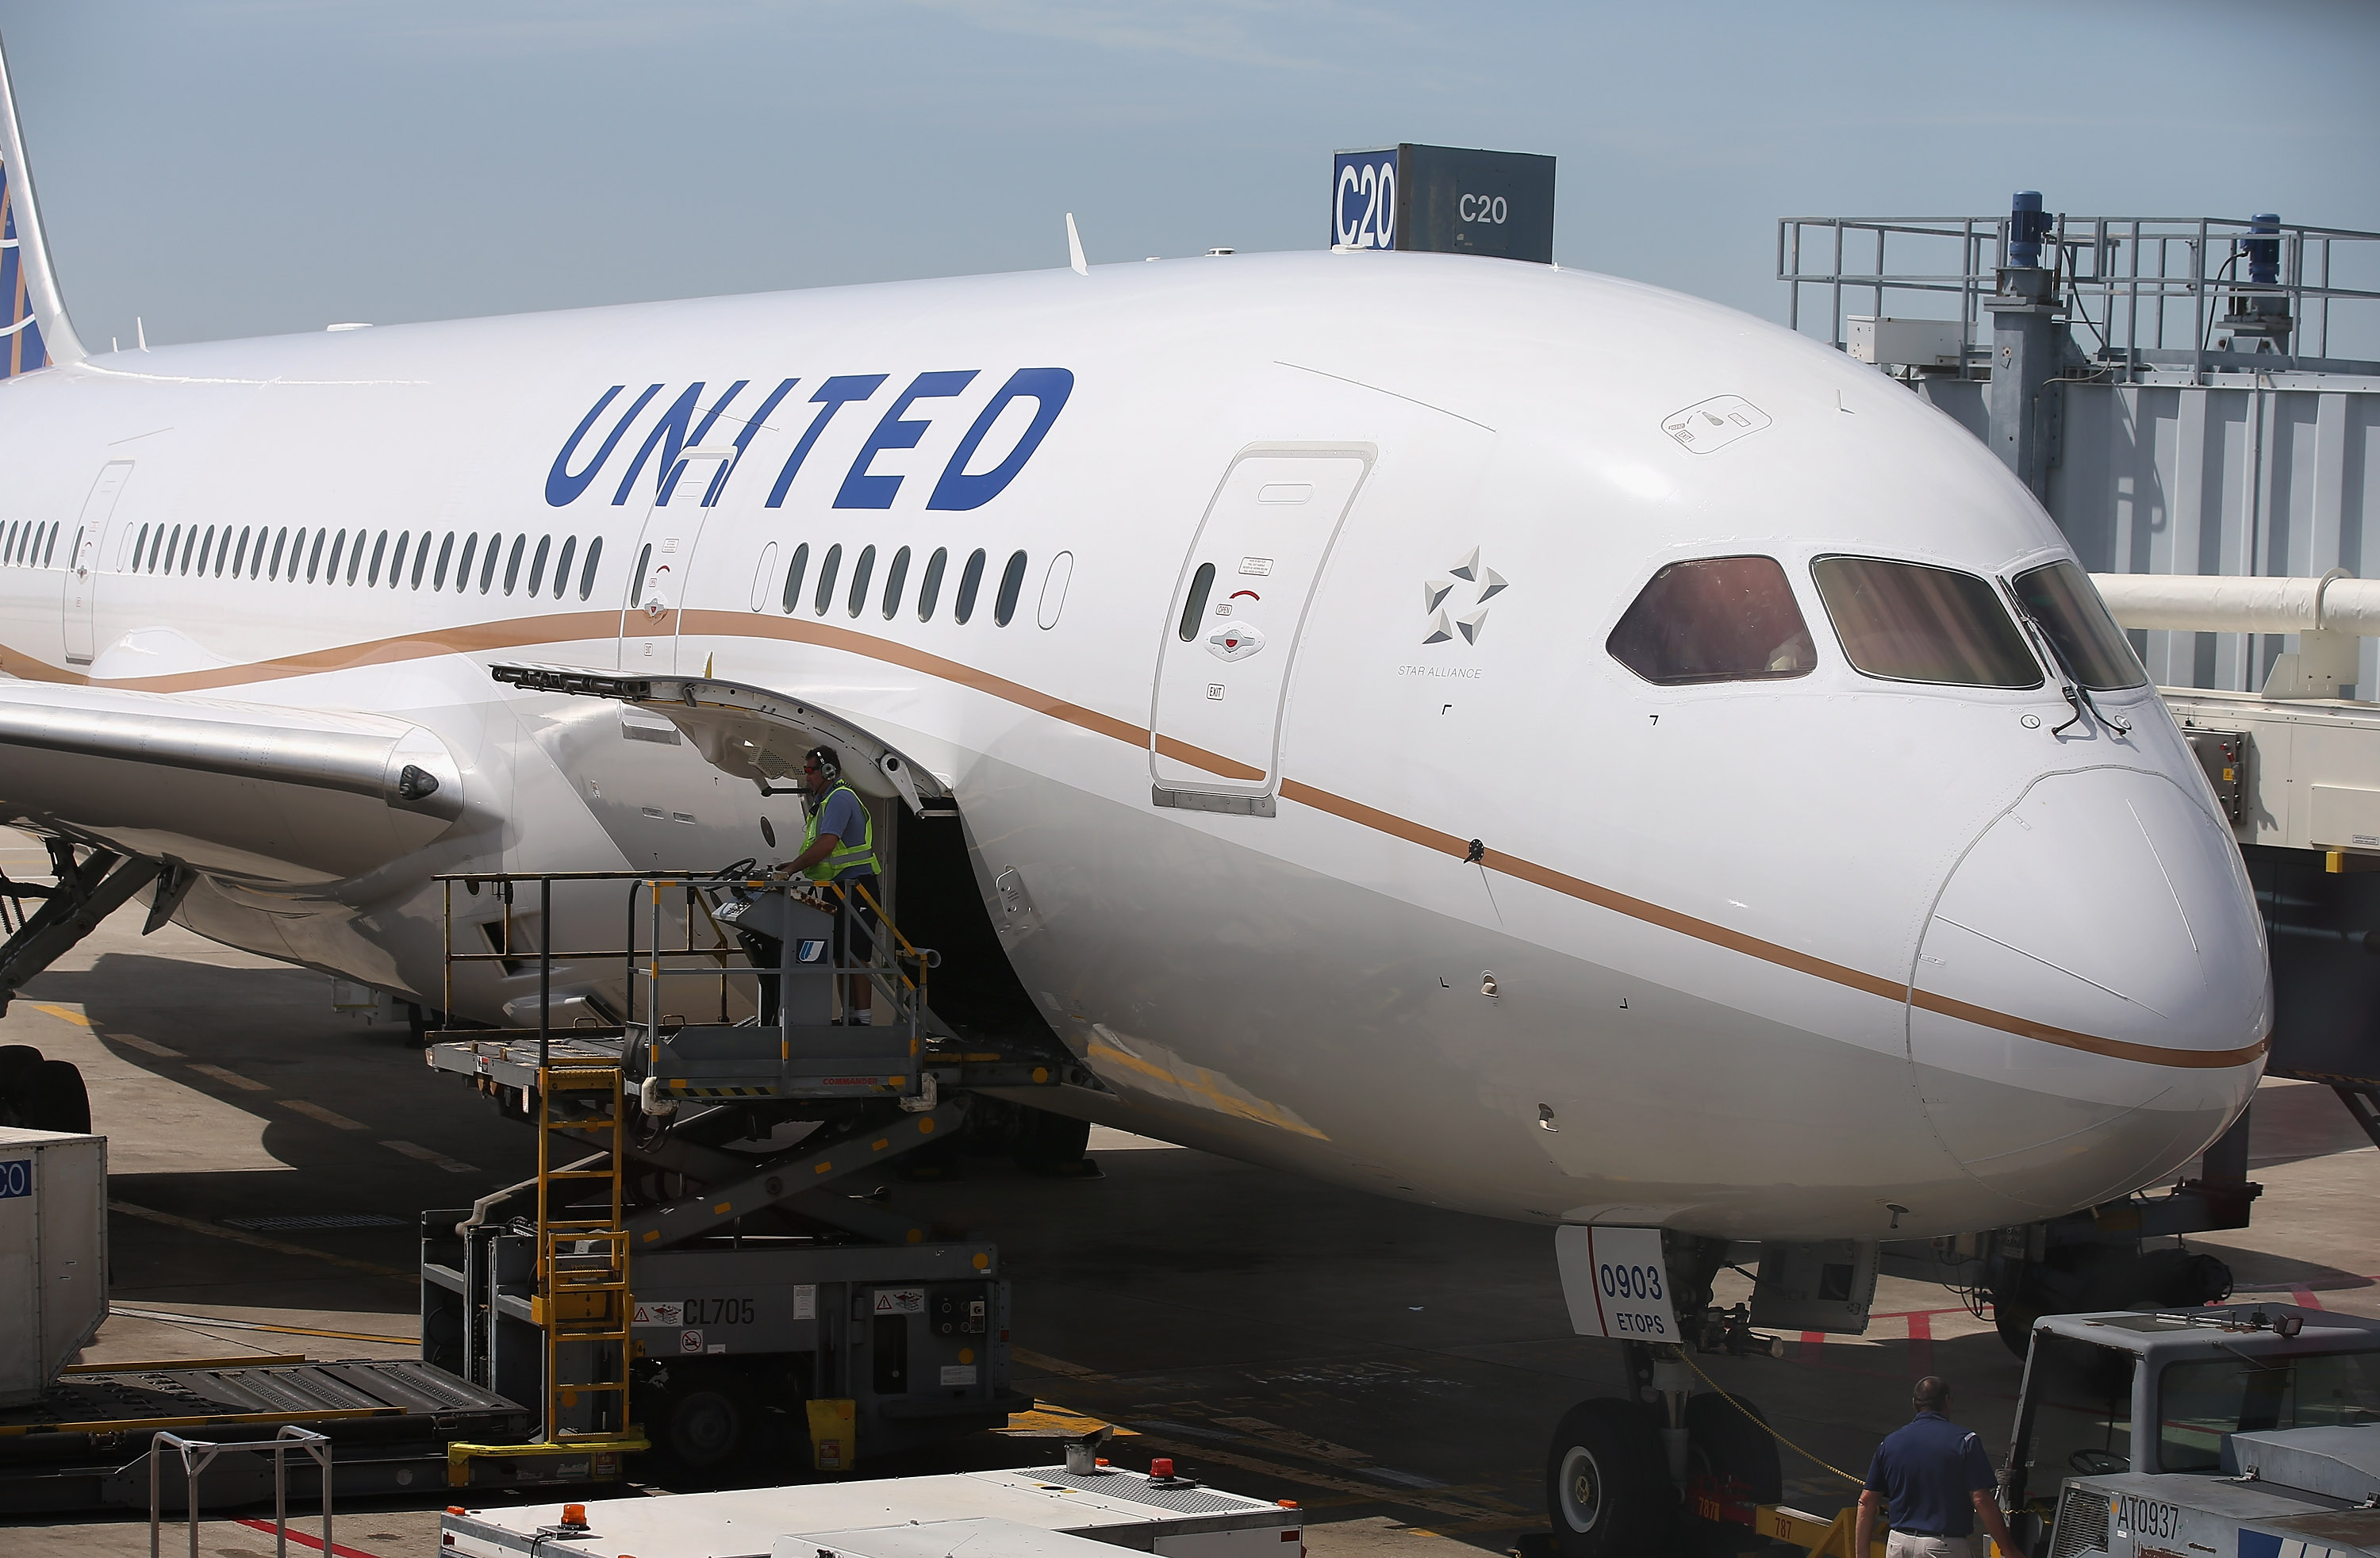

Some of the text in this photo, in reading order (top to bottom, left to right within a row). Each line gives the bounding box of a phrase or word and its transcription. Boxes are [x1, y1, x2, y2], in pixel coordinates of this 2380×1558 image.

[1336, 162, 1395, 248] C20
[1460, 194, 1507, 224] C20
[545, 368, 1074, 512] UNITED
[1398, 665, 1483, 679] STAR ALLIANCE
[1209, 687, 1222, 697] EXIT
[1600, 1263, 1663, 1300] 0903
[683, 1298, 755, 1325] CL705
[1616, 1311, 1665, 1334] ETOPS
[1775, 1517, 1792, 1539] 787
[2117, 1495, 2179, 1540] AT0937
